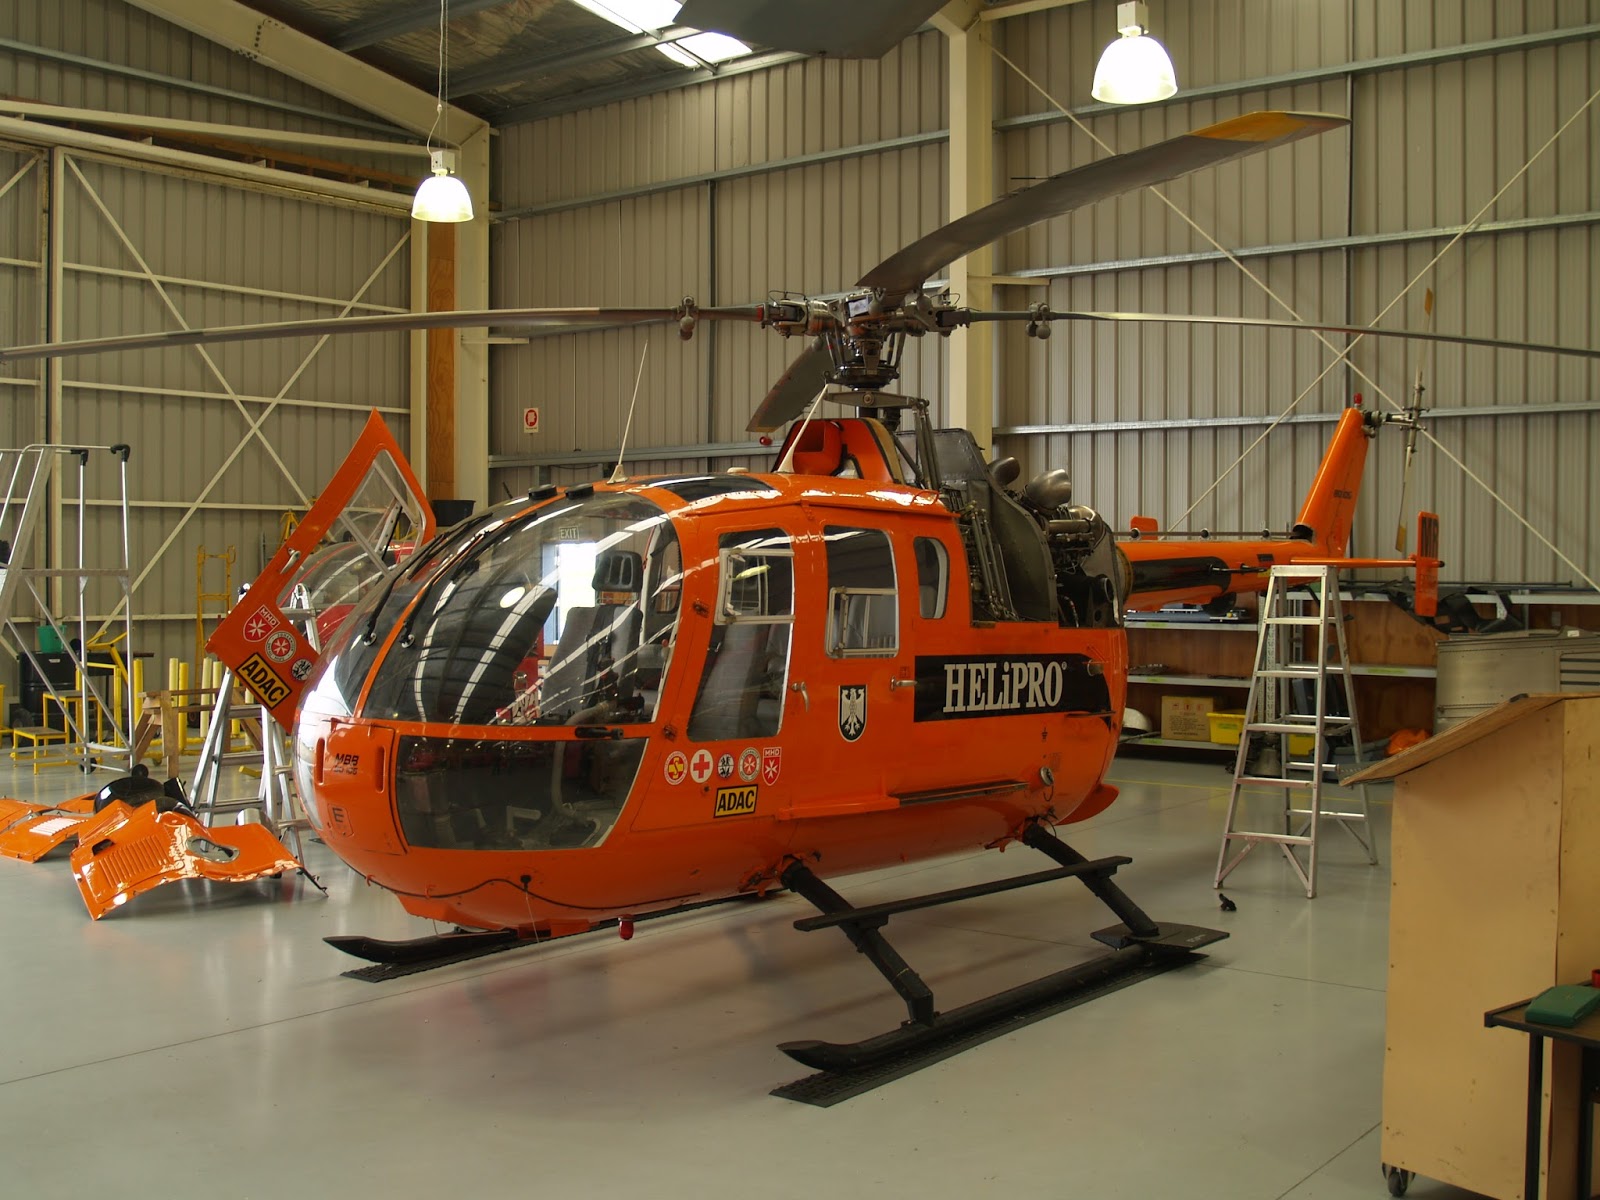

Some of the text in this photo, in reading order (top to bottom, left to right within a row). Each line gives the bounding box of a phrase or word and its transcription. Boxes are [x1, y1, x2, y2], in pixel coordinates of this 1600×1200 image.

[560, 527, 577, 539] EXIT
[260, 607, 277, 627] MHD
[242, 660, 285, 702] ADAC
[335, 753, 359, 766] MBB
[717, 790, 755, 813] ADAC
